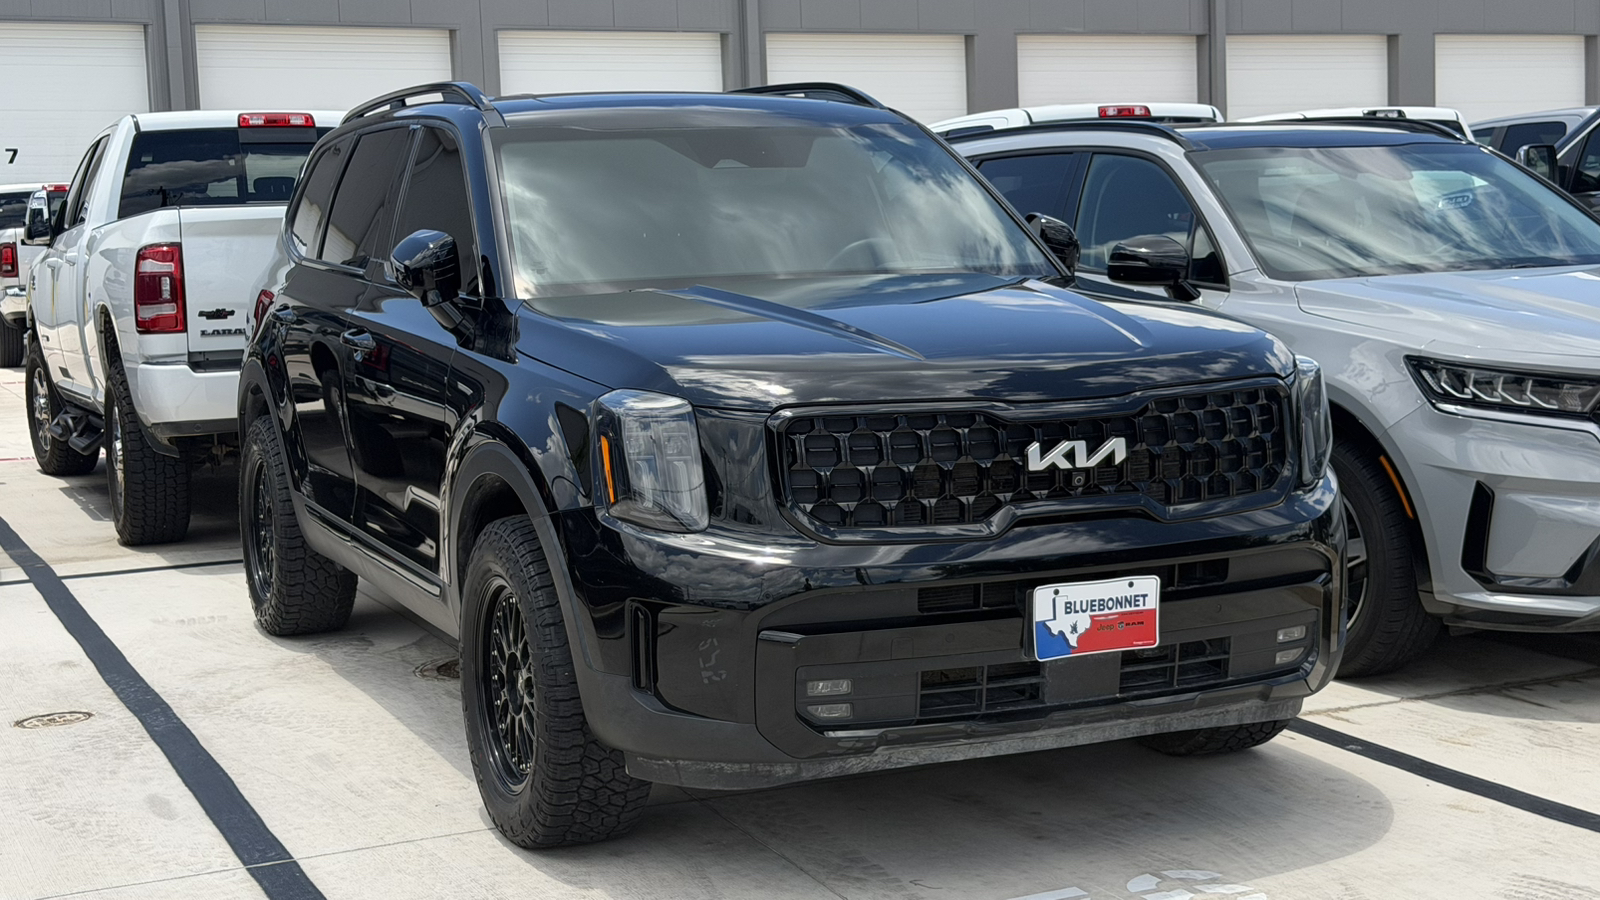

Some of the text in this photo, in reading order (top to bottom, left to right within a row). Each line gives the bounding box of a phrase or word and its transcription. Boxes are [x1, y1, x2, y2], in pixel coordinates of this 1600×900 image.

[5, 148, 19, 164] 7
[200, 328, 246, 336] LARA
[1026, 437, 1126, 471] KIA
[1064, 594, 1149, 615] BLUEBONNET
[1097, 623, 1115, 632] Jeep
